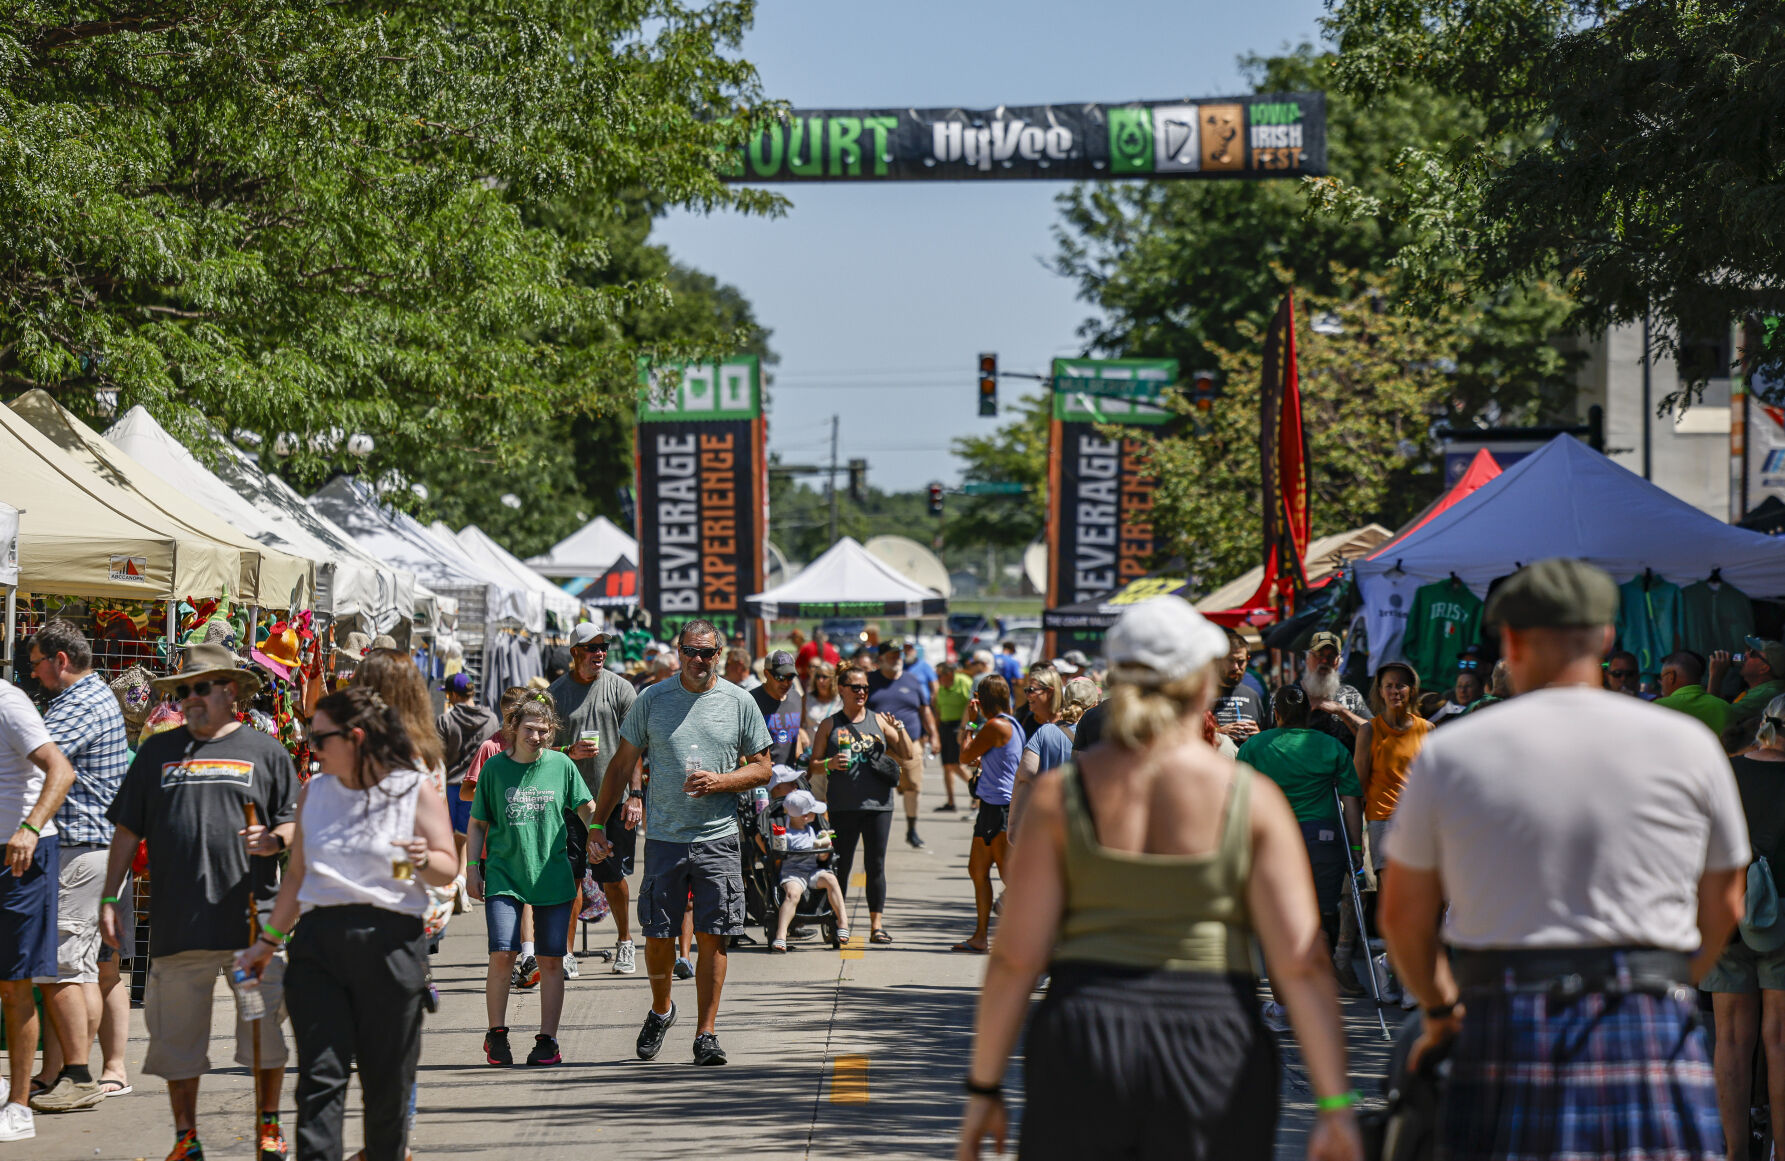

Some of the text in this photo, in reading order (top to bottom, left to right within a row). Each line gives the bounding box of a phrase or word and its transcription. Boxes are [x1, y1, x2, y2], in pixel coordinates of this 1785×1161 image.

[1249, 102, 1301, 126] IOWA
[1250, 124, 1303, 149] IRISH
[1252, 146, 1304, 170] FEST
[656, 432, 700, 613] BEVERAGE
[700, 431, 738, 611] EXPERIENCE
[660, 613, 738, 642] STET
[185, 763, 241, 777] Columbia
[526, 803, 546, 811] Day
